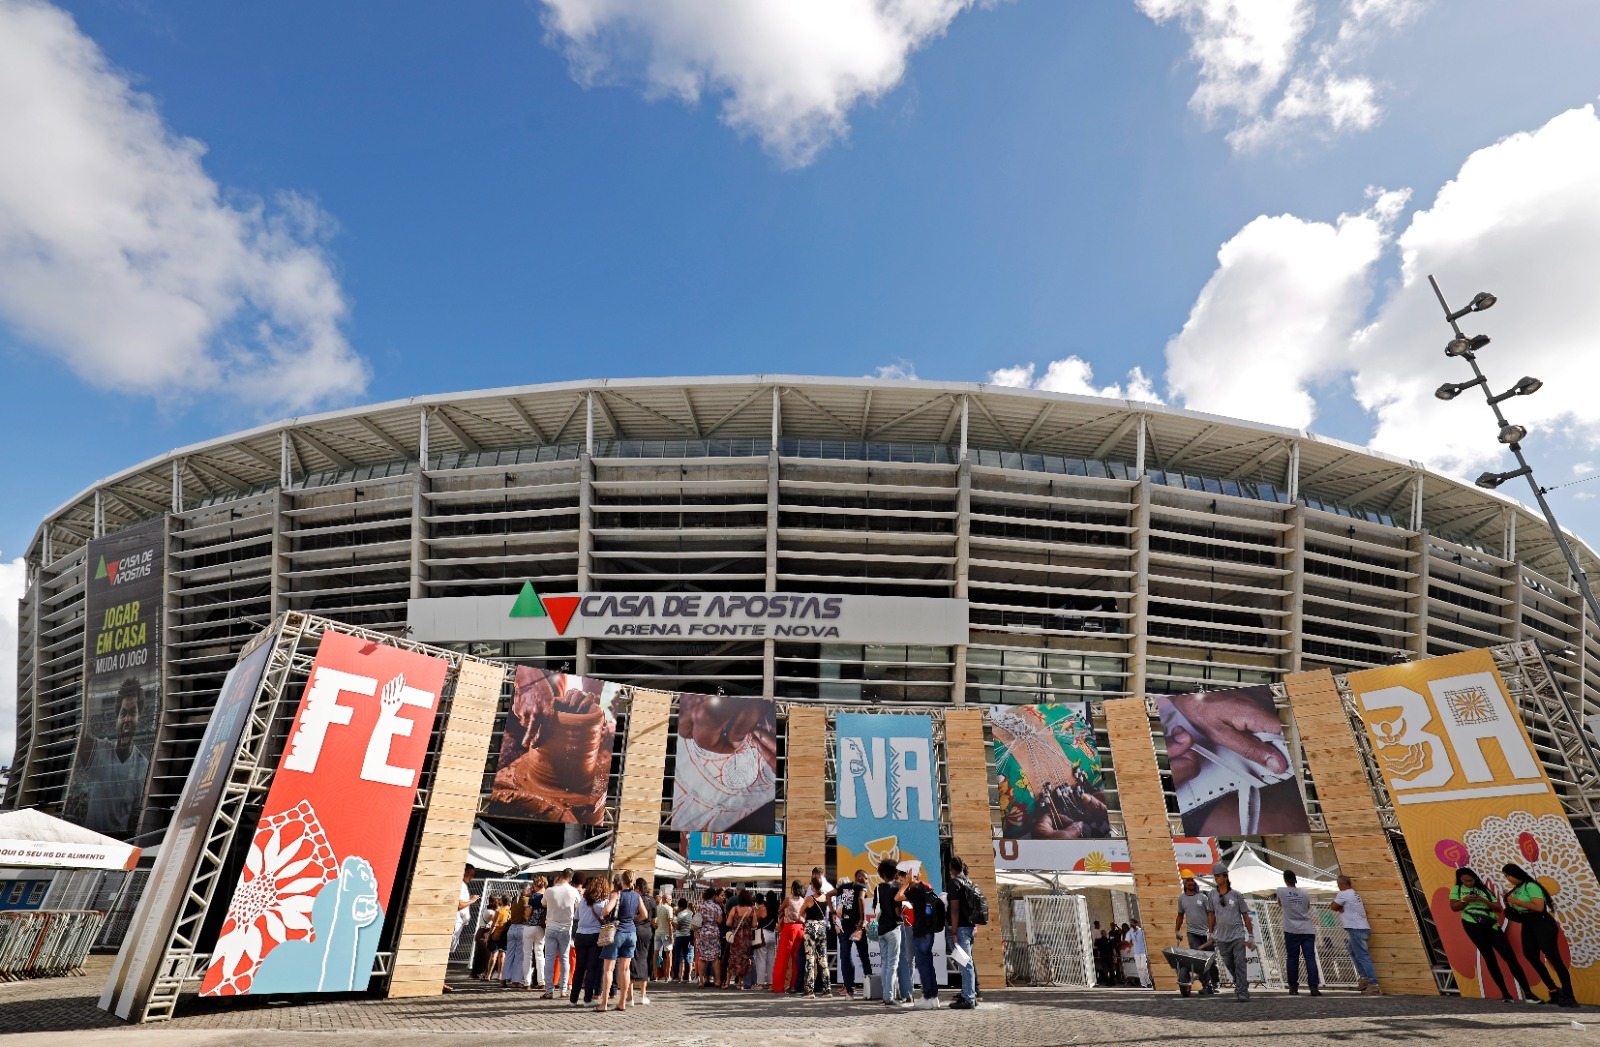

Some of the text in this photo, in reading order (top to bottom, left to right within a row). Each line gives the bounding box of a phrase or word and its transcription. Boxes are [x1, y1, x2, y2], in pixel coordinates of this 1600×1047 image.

[119, 549, 154, 571] CASA DE
[113, 563, 152, 585] APOSTAS
[102, 601, 140, 630] JOGAR
[580, 595, 843, 619] CASA DE APOSTAS
[96, 622, 147, 655] EM CASA
[604, 623, 840, 638] ARENA FONTE NOVA
[96, 648, 148, 674] MUDA O JOGO
[1360, 671, 1542, 790] BA
[840, 736, 935, 821] NA
[67, 852, 105, 860] ALIMENTO
